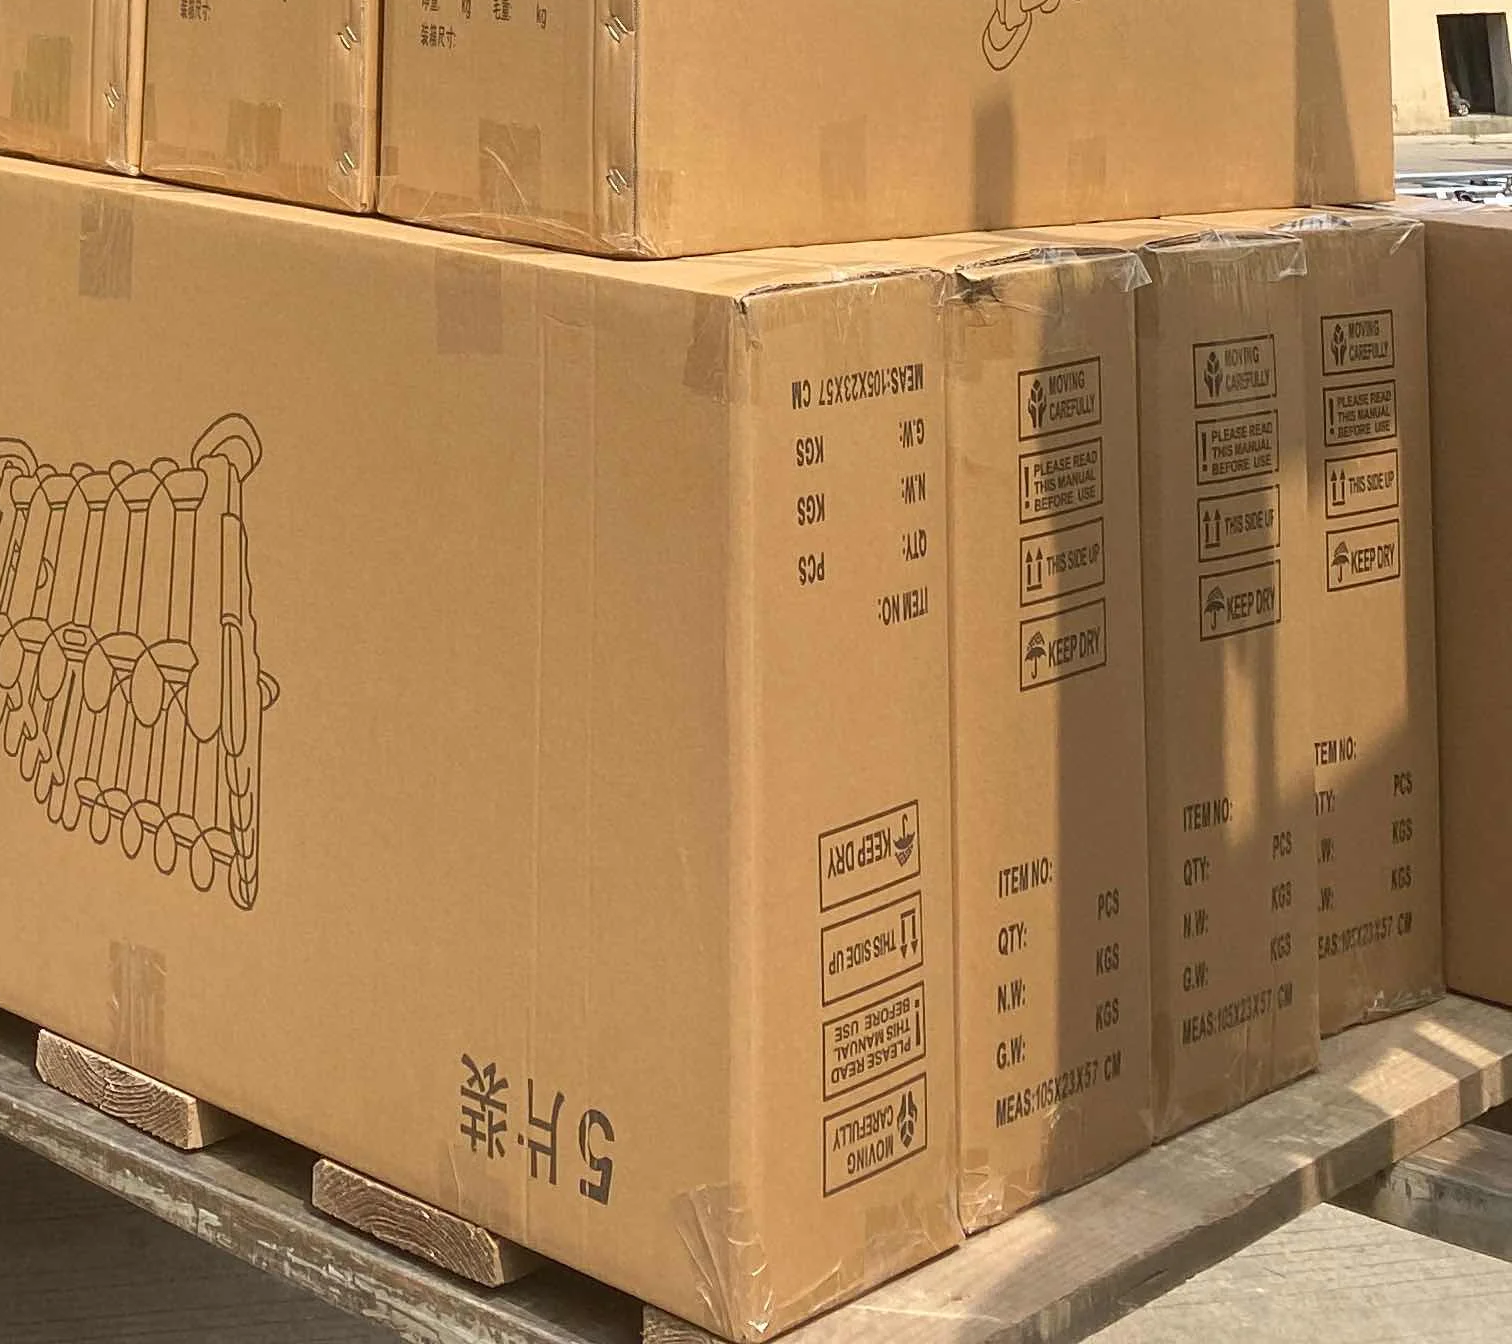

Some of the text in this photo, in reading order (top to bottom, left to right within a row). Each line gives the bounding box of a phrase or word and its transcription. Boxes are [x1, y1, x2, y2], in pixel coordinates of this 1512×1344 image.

[1348, 319, 1380, 339] MOVING
[1224, 345, 1259, 366] MOVING
[1348, 339, 1389, 361] CAREFULLY
[791, 379, 811, 410] CM
[1048, 370, 1085, 395] MOVING
[1225, 368, 1270, 392] CAREFULLY
[1049, 393, 1095, 420] CAREFULLY
[796, 418, 924, 466] G.W: KGS
[1211, 420, 1273, 444] PLEASE READ
[1212, 439, 1272, 459] THIS MANUAL
[1034, 450, 1097, 477] PLEASE READ
[1211, 454, 1272, 477] BEFORE USE
[1034, 468, 1096, 495] THIS MANUAL
[1034, 485, 1096, 512] BEFORE USE
[1348, 470, 1395, 493] THIS SIDE UP
[797, 472, 926, 526] N.W: KGS
[1224, 513, 1243, 535] THIS
[1244, 511, 1261, 533] SIDE
[799, 528, 926, 585] QTY: PCS
[1046, 543, 1100, 577] THIS SIDE UP
[1351, 541, 1395, 575] KEEP DRY
[878, 586, 928, 626] ITEM NO:
[1227, 584, 1276, 621] KEEP DRY
[1048, 627, 1101, 668] KEEP DRY
[1340, 736, 1357, 762] NO:
[1393, 771, 1413, 797] PCS
[1183, 798, 1232, 833] ITEM NO:
[1392, 818, 1413, 845] KGS
[827, 827, 891, 878] KEEP DRY
[1183, 832, 1292, 887] QTY: PCS
[998, 856, 1053, 899] ITEM NO:
[1391, 866, 1412, 892] KGS
[998, 889, 1120, 956] QTY: PCS
[1183, 882, 1292, 940] N.W: KGS
[1398, 913, 1412, 936] CM
[829, 929, 896, 975] THIS SIDE UP
[1183, 933, 1291, 992] G.W: KGS
[997, 943, 1120, 1015] N.W: KGS
[1278, 982, 1293, 1010] CM
[835, 997, 911, 1042] BEFORE USE
[996, 997, 1120, 1071] G.W: KGS
[835, 1017, 911, 1061] THIS MANUAL
[831, 1037, 912, 1084] PLEASE READ
[1105, 1056, 1122, 1082] CM
[461, 1053, 615, 1205] 5片装
[832, 1104, 894, 1152] CAREFULLY
[848, 1134, 894, 1174] MOVING
